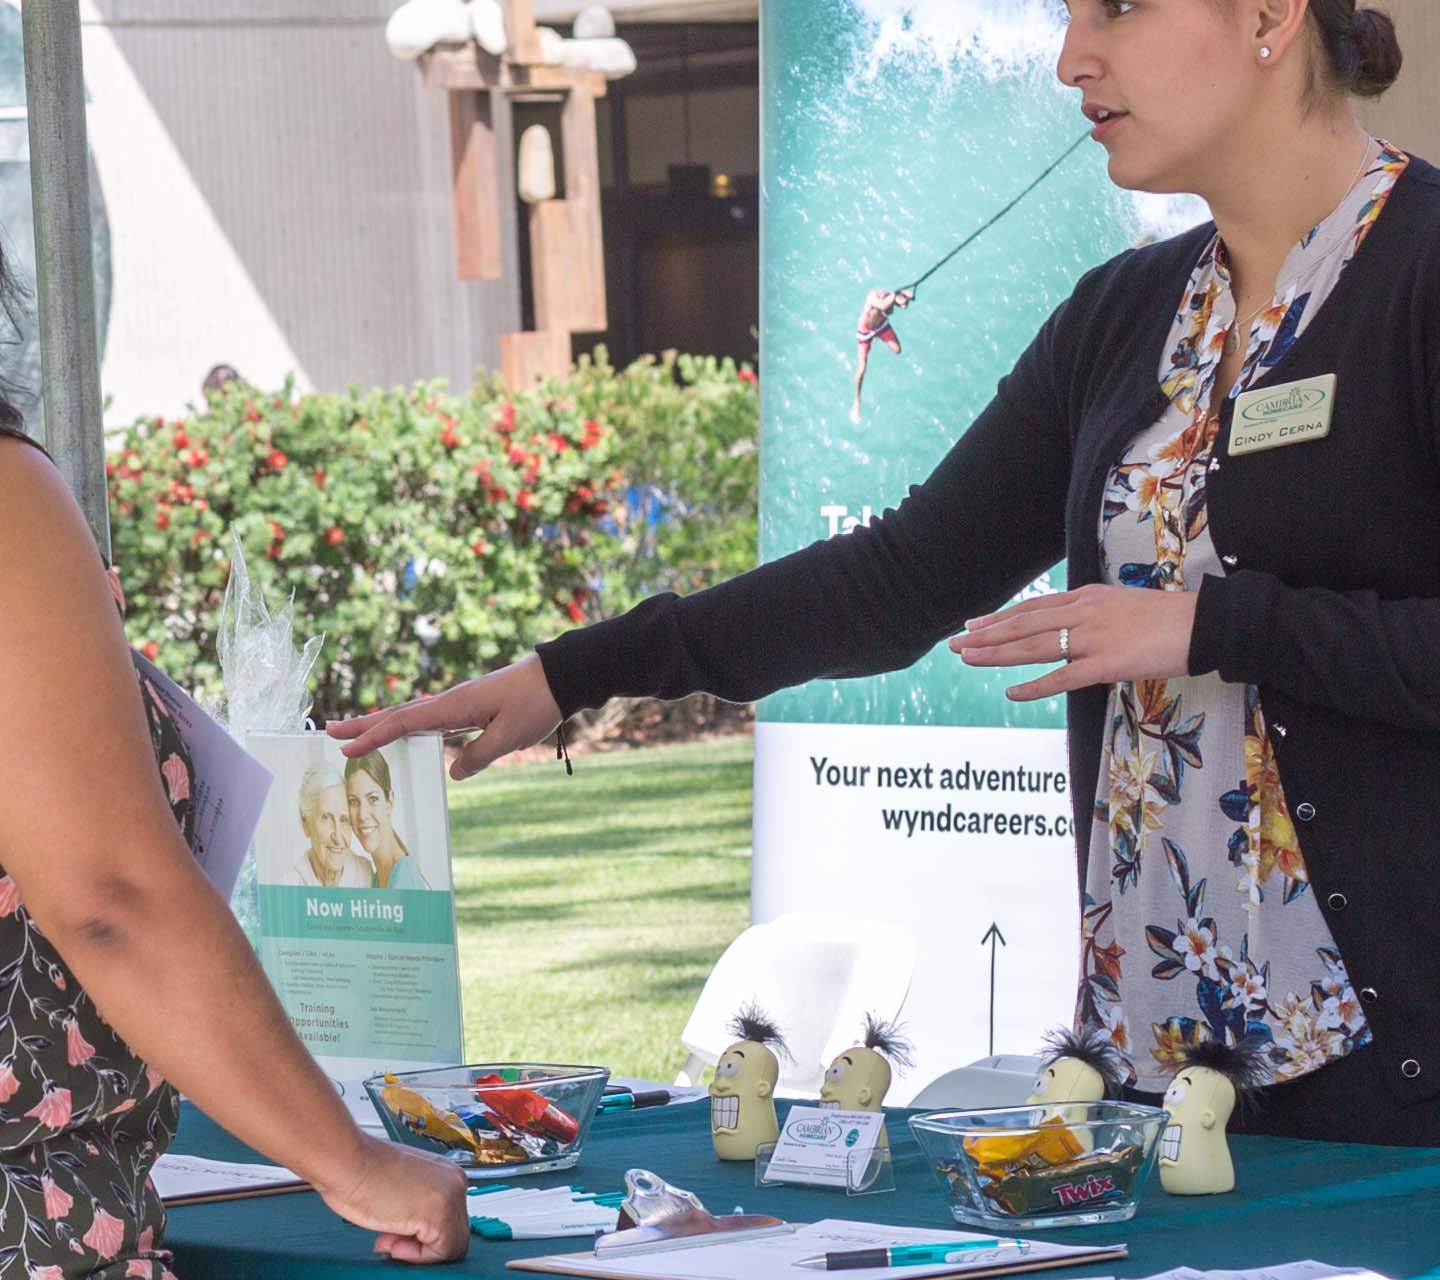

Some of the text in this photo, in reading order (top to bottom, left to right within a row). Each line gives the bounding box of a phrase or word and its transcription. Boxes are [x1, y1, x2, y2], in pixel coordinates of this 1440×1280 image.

[1234, 431, 1274, 447] CINDY
[1279, 421, 1323, 437] CERNA
[809, 756, 1067, 794] Your next adventure
[306, 897, 405, 923] Now Hiring
[300, 1002, 336, 1016] Training
[1051, 1174, 1115, 1207] Twix
